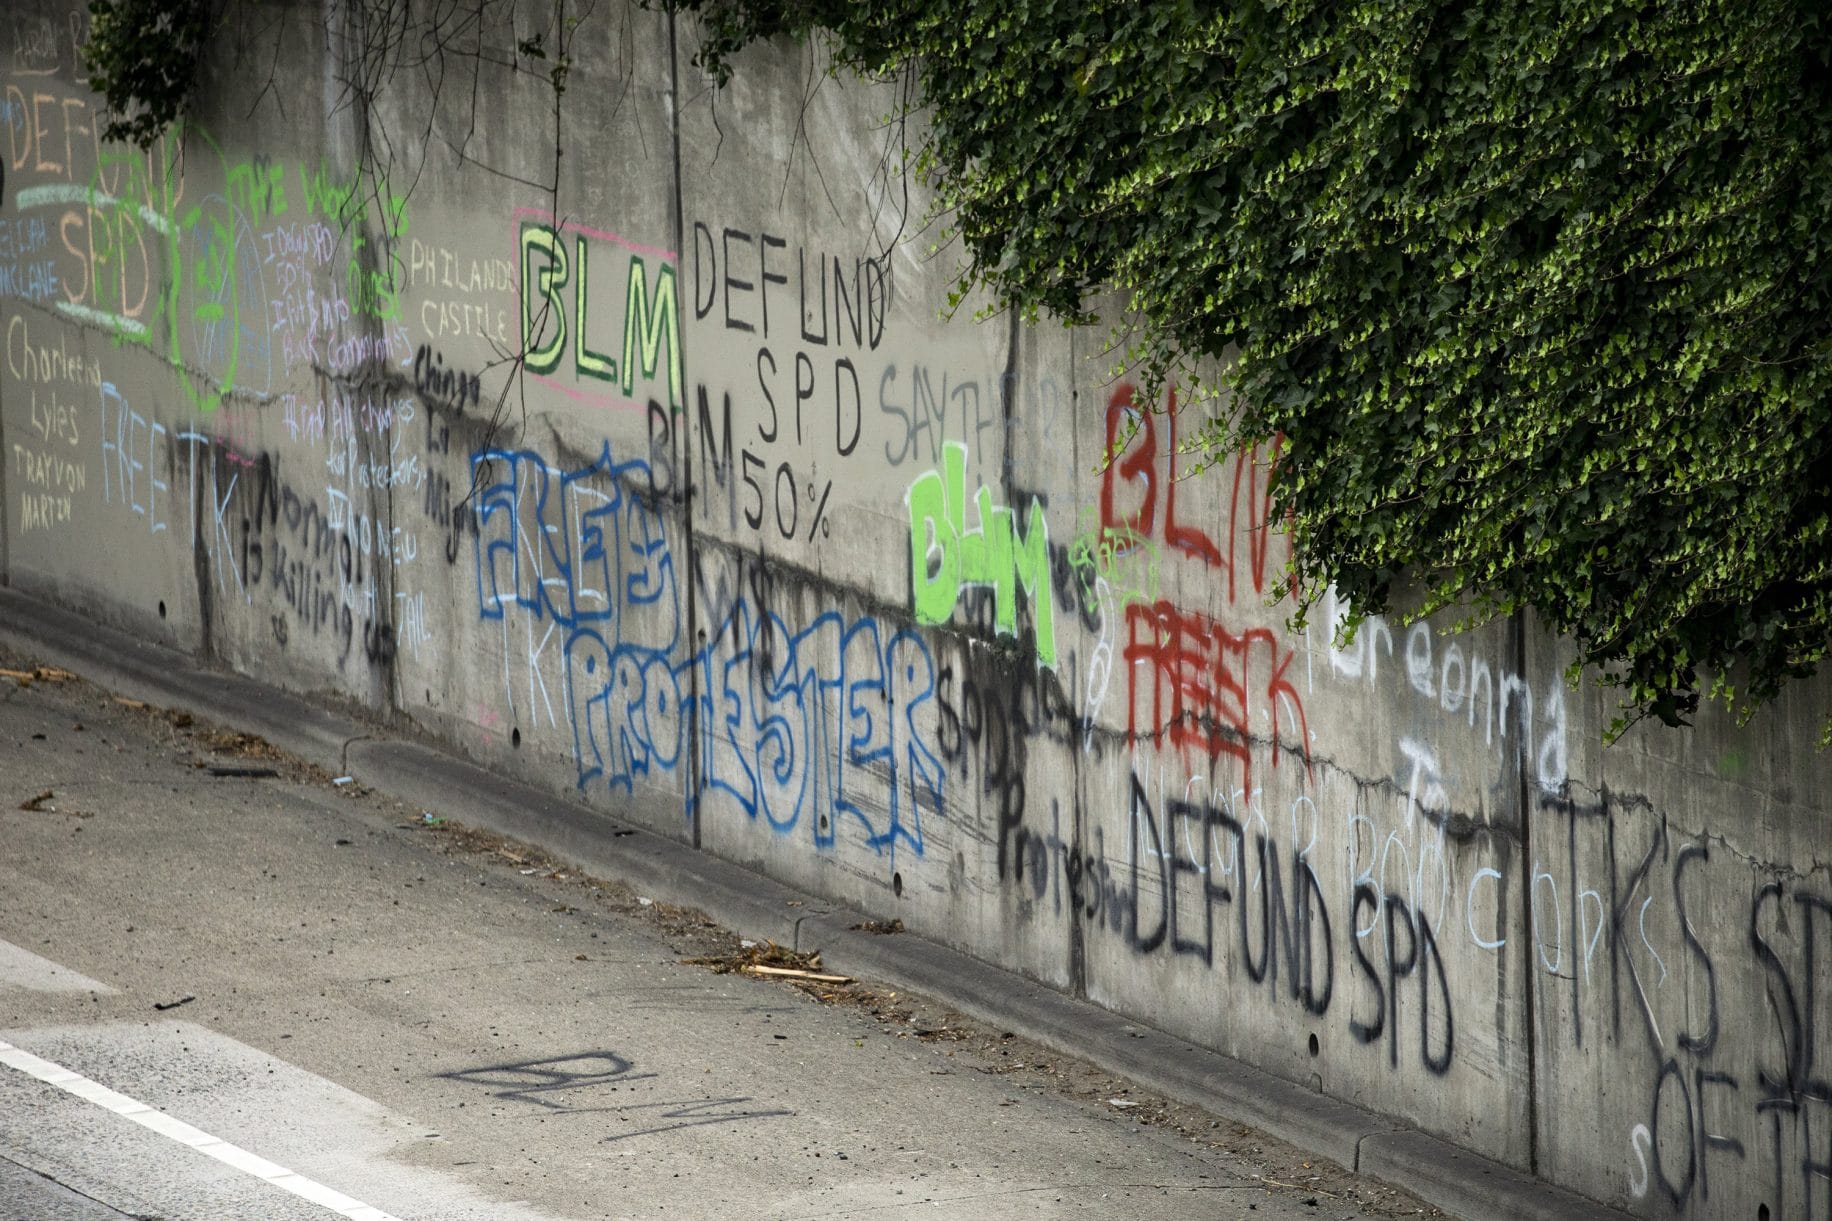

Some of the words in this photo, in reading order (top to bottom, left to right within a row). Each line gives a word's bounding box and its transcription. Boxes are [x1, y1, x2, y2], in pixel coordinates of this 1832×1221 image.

[519, 222, 683, 413] BLM
[694, 220, 888, 351] DEFUND
[31, 390, 80, 444] Lyles
[103, 380, 168, 534] FREE
[756, 346, 862, 457] SPD
[878, 364, 948, 468] SAY
[13, 444, 87, 493] TRAYVON
[740, 447, 833, 545] 50%
[903, 438, 1060, 674] BLM
[1128, 768, 1334, 1010] DEFUND
[1350, 882, 1456, 1080] SPD
